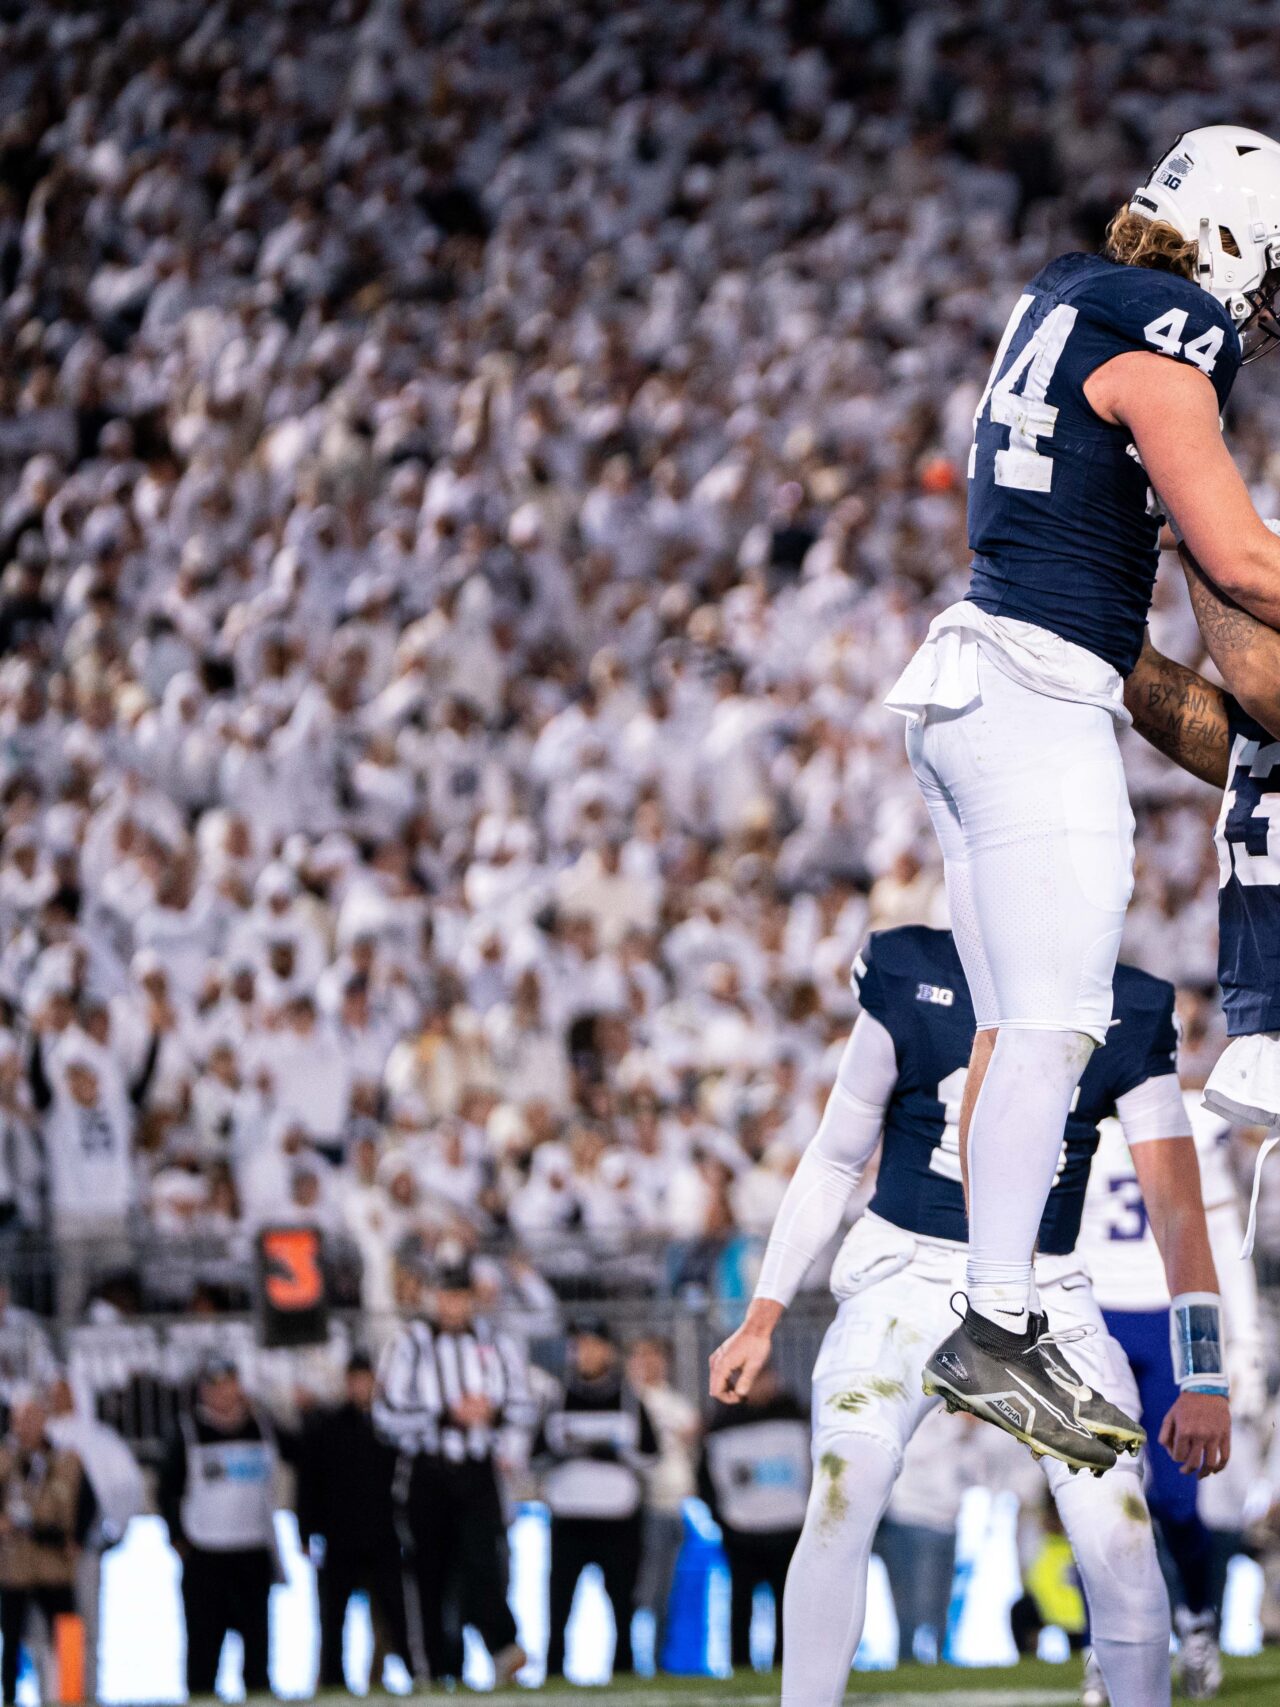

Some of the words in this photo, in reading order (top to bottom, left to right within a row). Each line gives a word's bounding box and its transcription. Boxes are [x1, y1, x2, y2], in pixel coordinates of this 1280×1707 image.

[1143, 307, 1225, 377] 44
[264, 1231, 321, 1309] 3
[994, 1399, 1022, 1425] ALPHA
